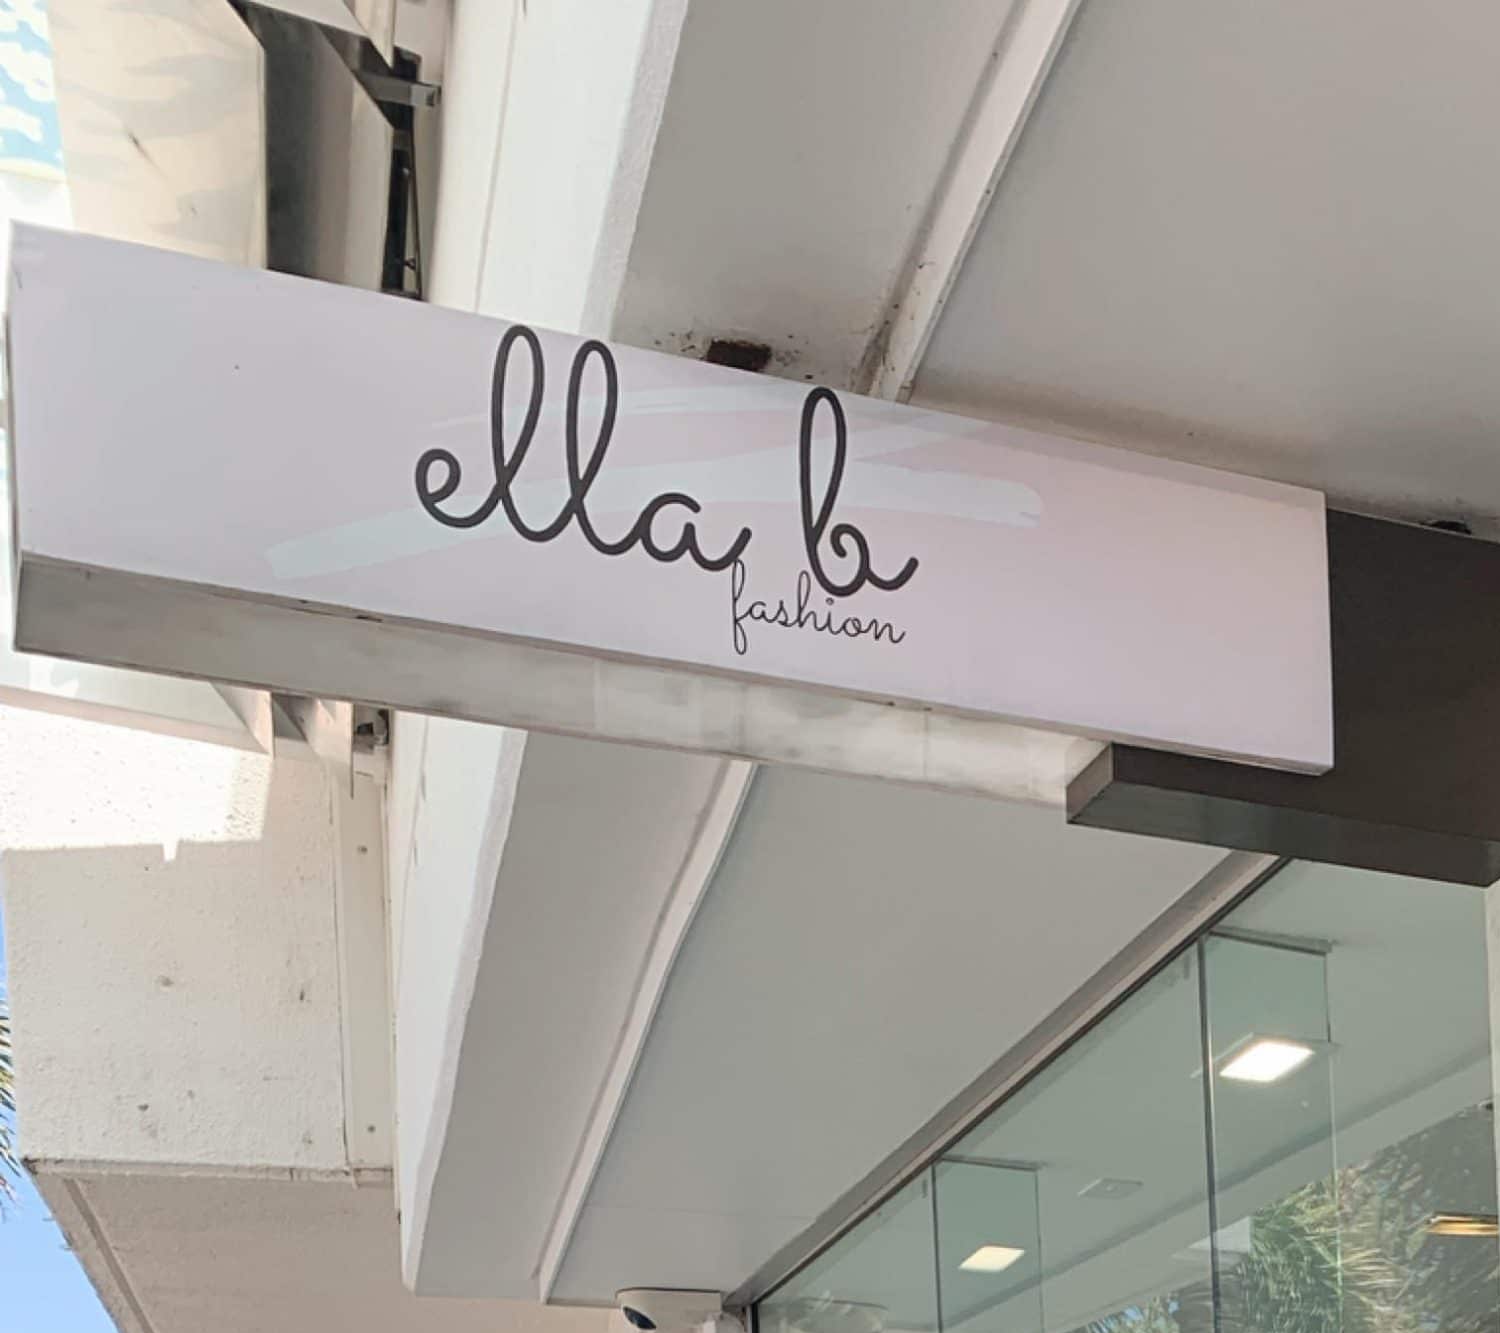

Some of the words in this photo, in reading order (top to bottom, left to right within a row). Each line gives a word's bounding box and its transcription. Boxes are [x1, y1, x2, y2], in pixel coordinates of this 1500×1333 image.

[414, 323, 752, 571] ella
[798, 386, 919, 597] b
[730, 558, 907, 655] fashion
